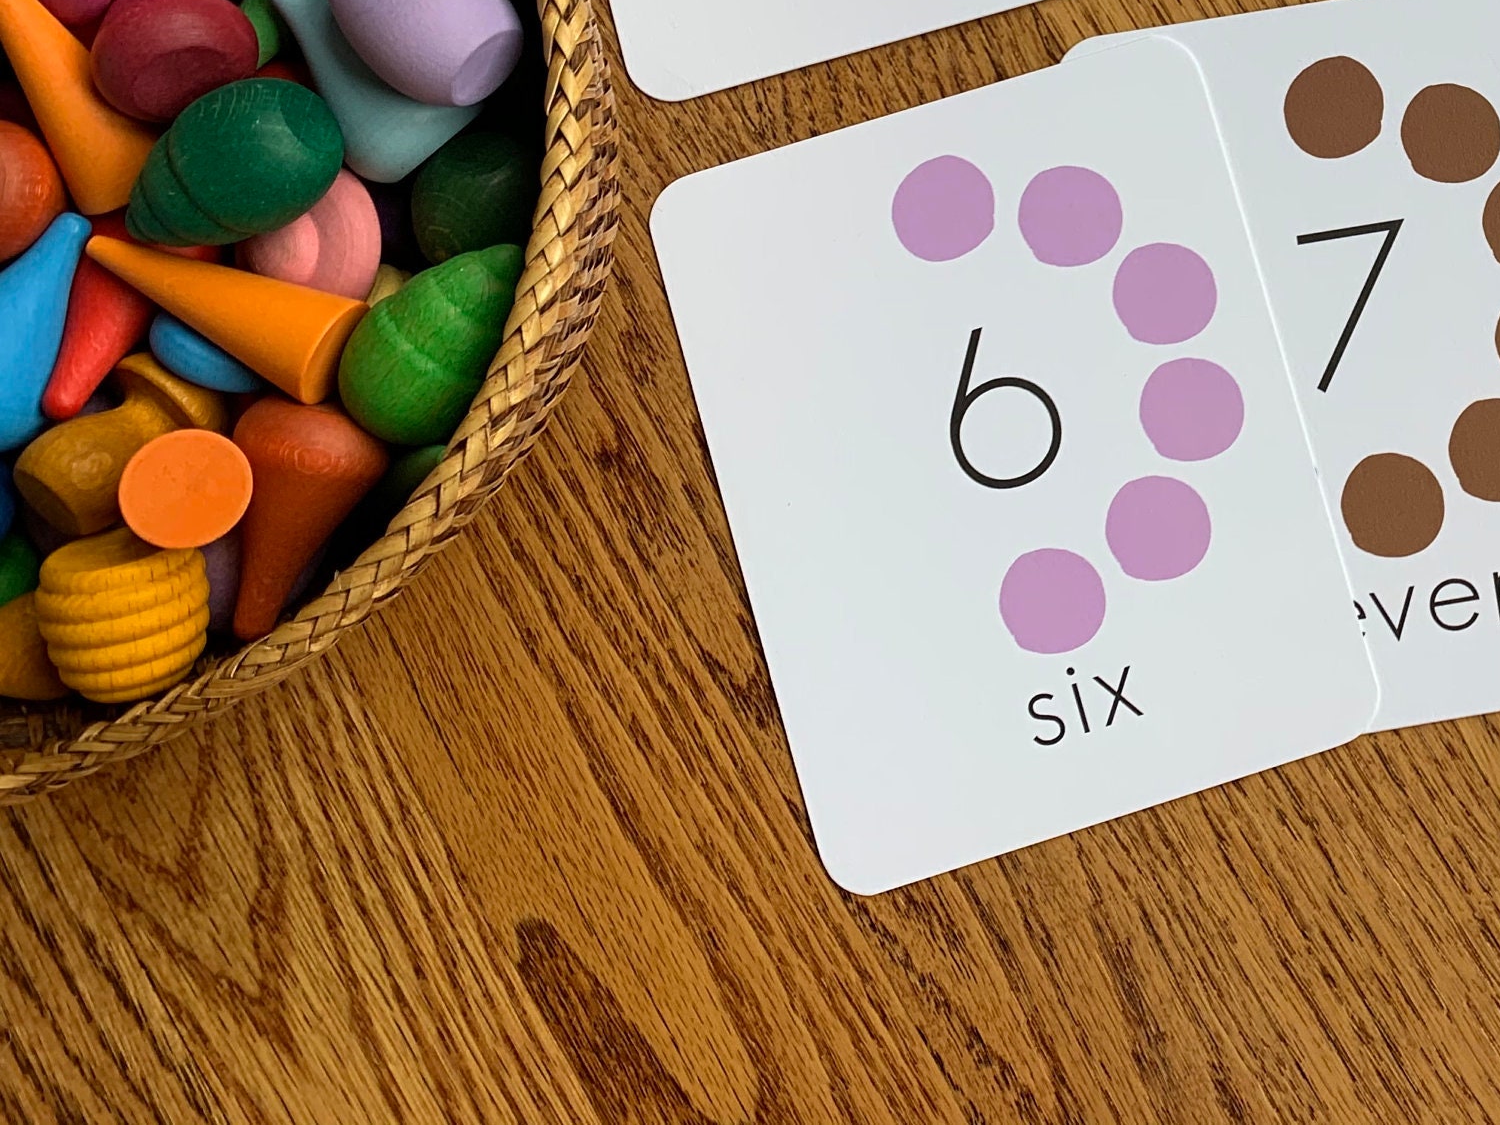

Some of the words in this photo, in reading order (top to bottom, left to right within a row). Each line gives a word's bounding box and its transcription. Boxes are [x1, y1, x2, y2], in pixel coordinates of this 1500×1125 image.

[1295, 217, 1406, 394] 7
[948, 326, 1063, 491] 6
[1027, 664, 1145, 747] six
